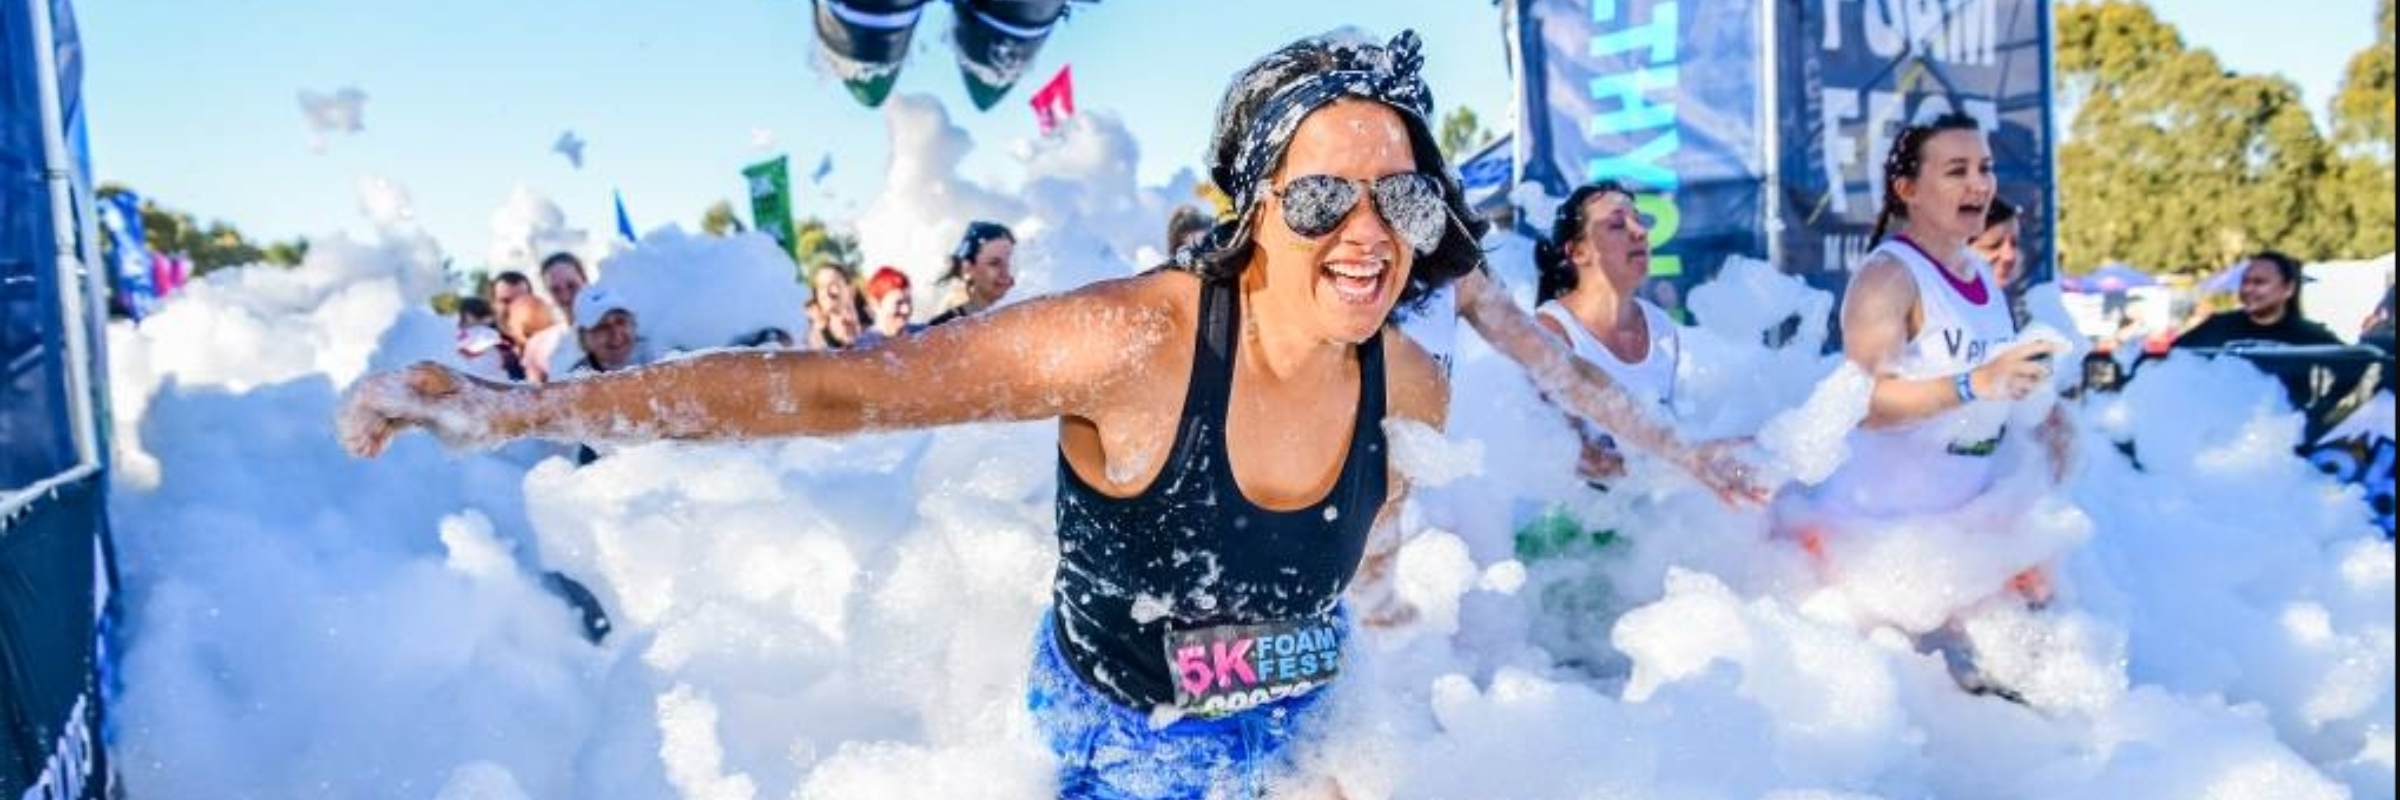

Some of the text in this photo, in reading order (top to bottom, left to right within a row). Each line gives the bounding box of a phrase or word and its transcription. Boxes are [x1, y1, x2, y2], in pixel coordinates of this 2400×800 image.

[1178, 628, 1336, 697] 5K FOAM
[1257, 650, 1338, 682] FEST
